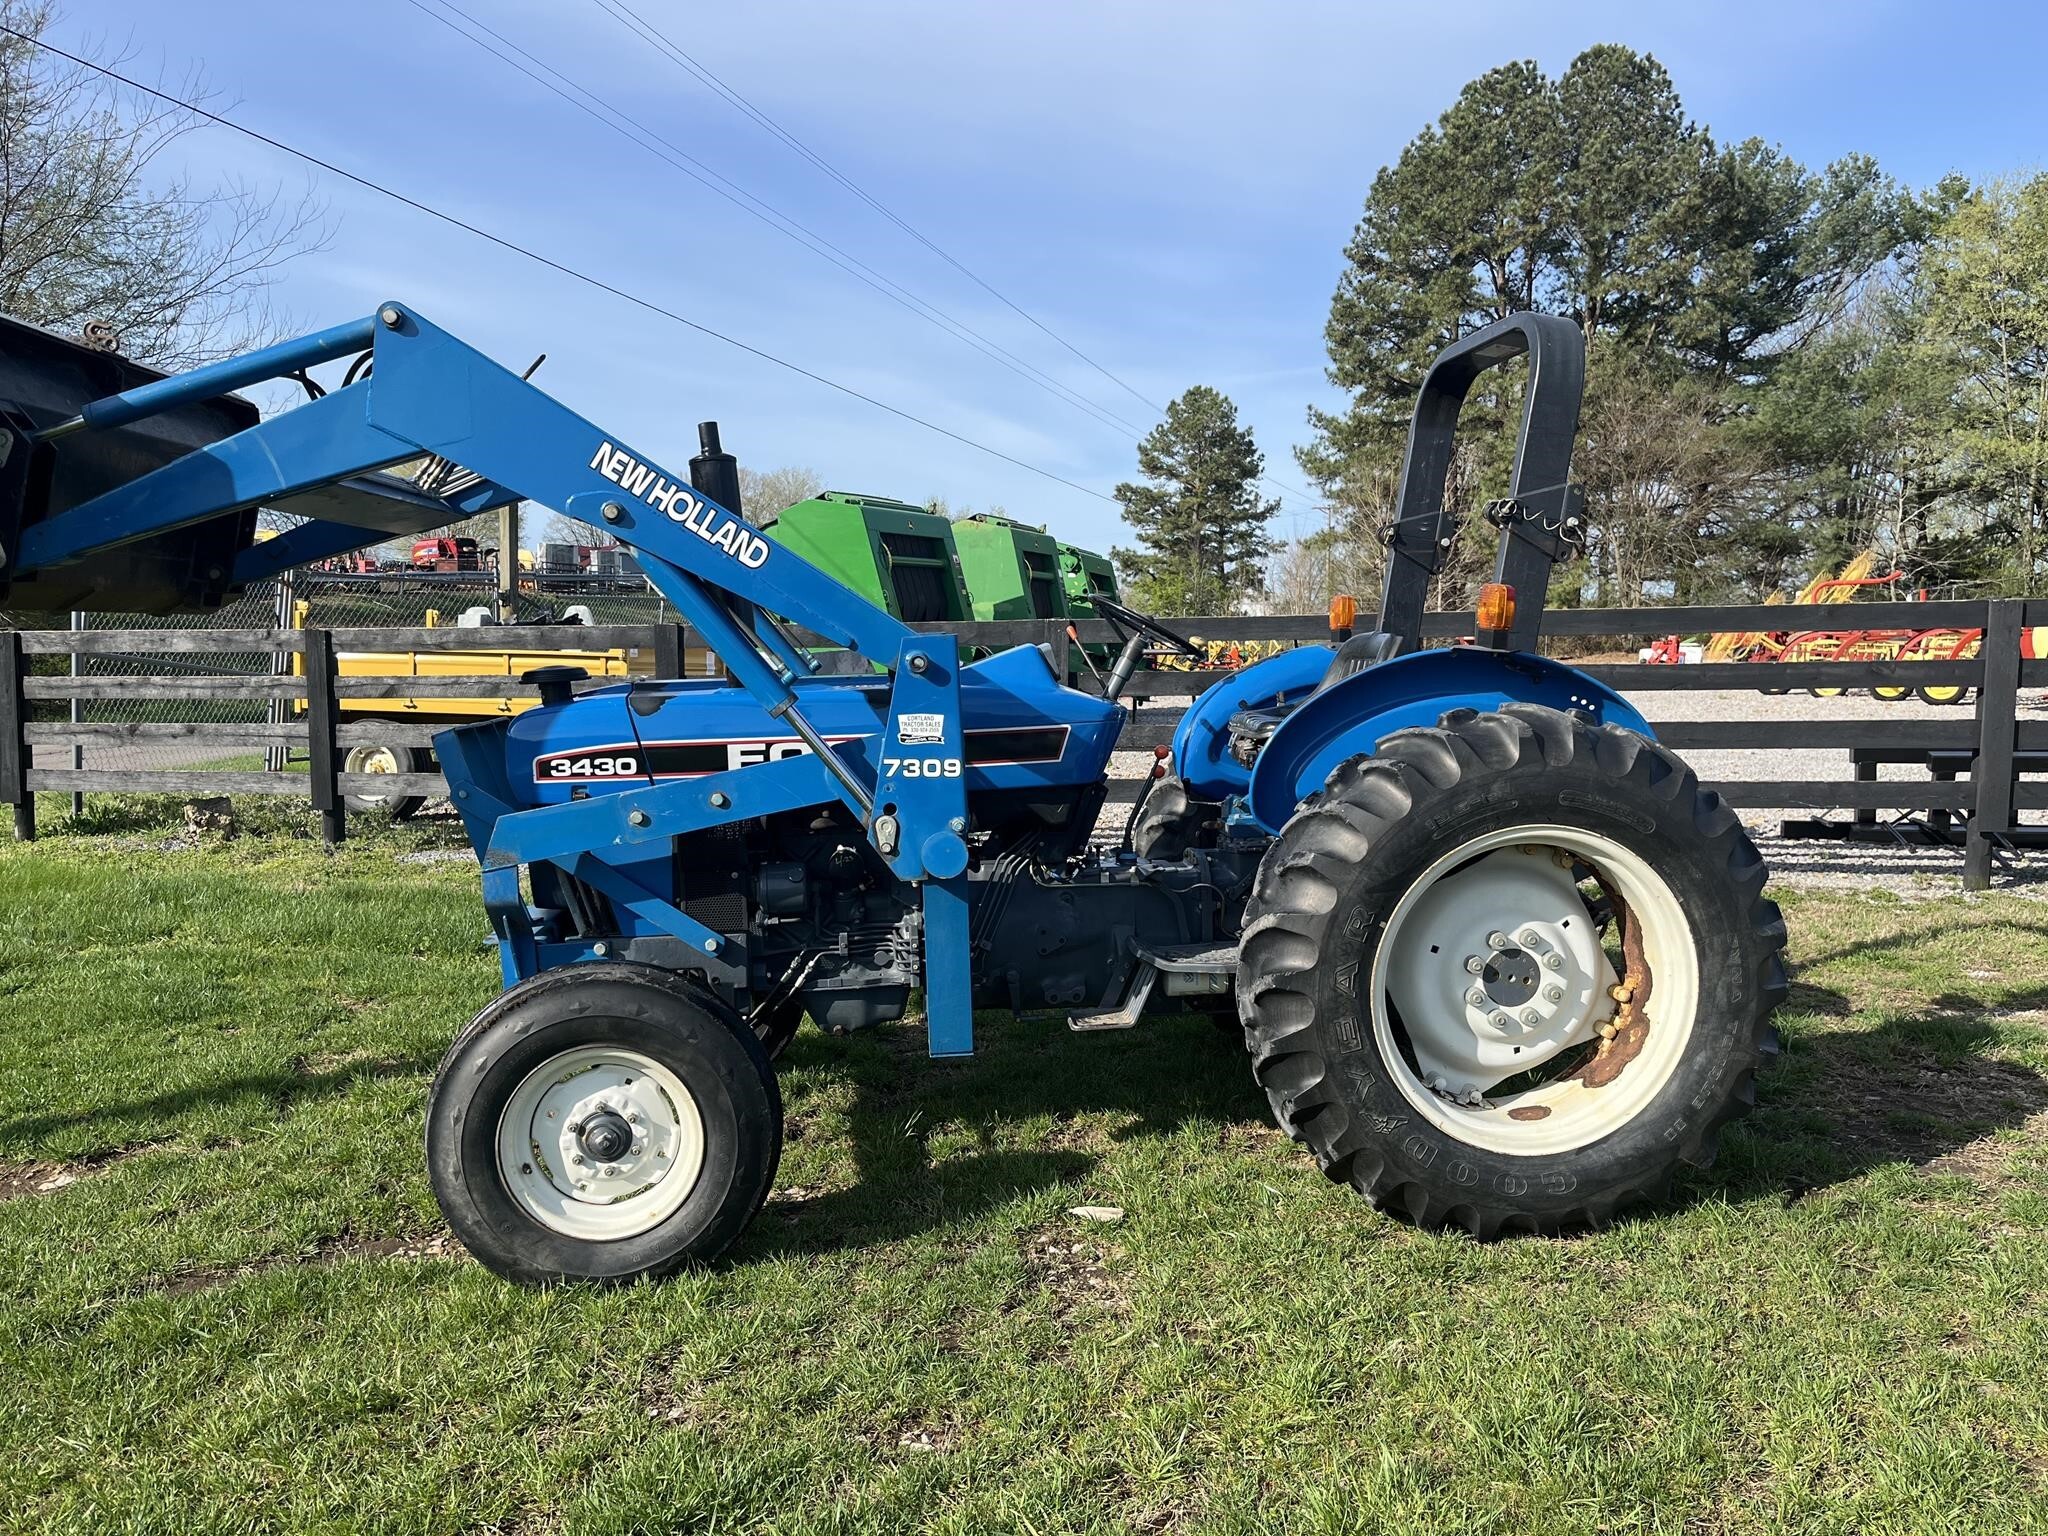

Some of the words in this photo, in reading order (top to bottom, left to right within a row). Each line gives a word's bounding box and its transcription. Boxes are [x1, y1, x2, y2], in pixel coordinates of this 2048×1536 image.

[588, 440, 656, 498] NEW
[646, 478, 770, 569] HOLLAND
[550, 757, 637, 777] 3430
[883, 758, 961, 778] 7309
[1334, 904, 1577, 1197] GOODYEAR
